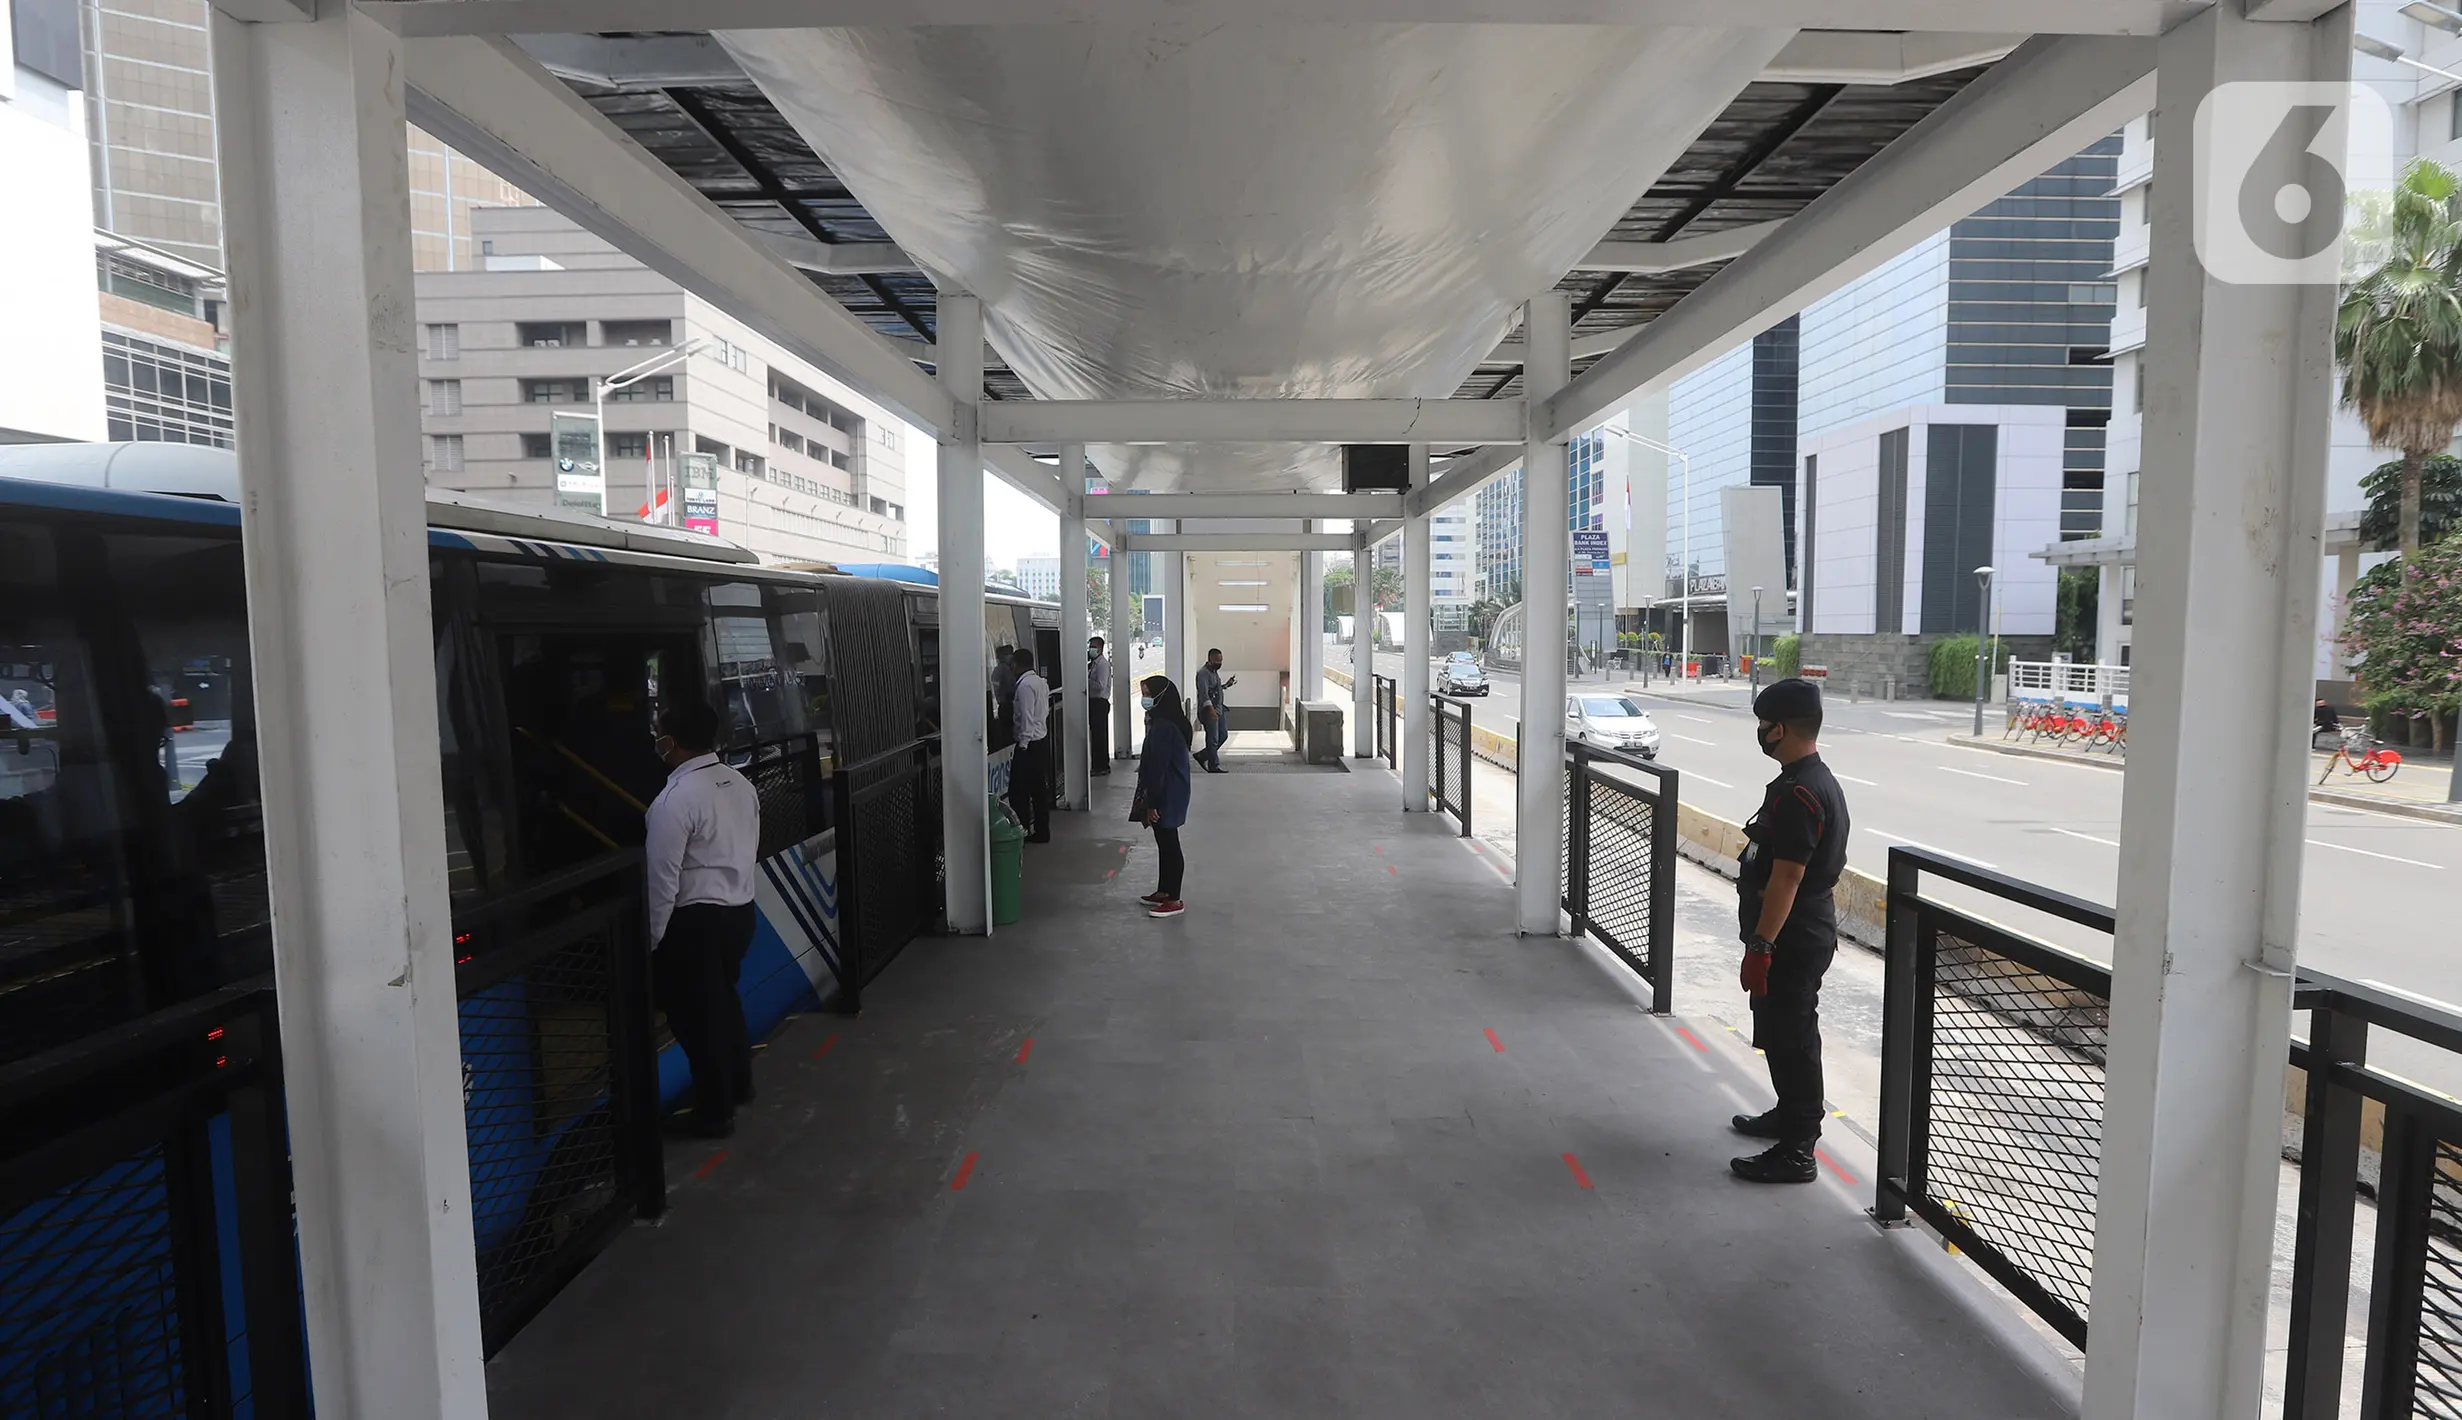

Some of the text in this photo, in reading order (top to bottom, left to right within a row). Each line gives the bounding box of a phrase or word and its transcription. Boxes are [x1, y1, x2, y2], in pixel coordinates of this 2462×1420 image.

[685, 466, 714, 480] IBM
[687, 505, 715, 515] BRANZ
[1690, 577, 1713, 593] PLAZA
